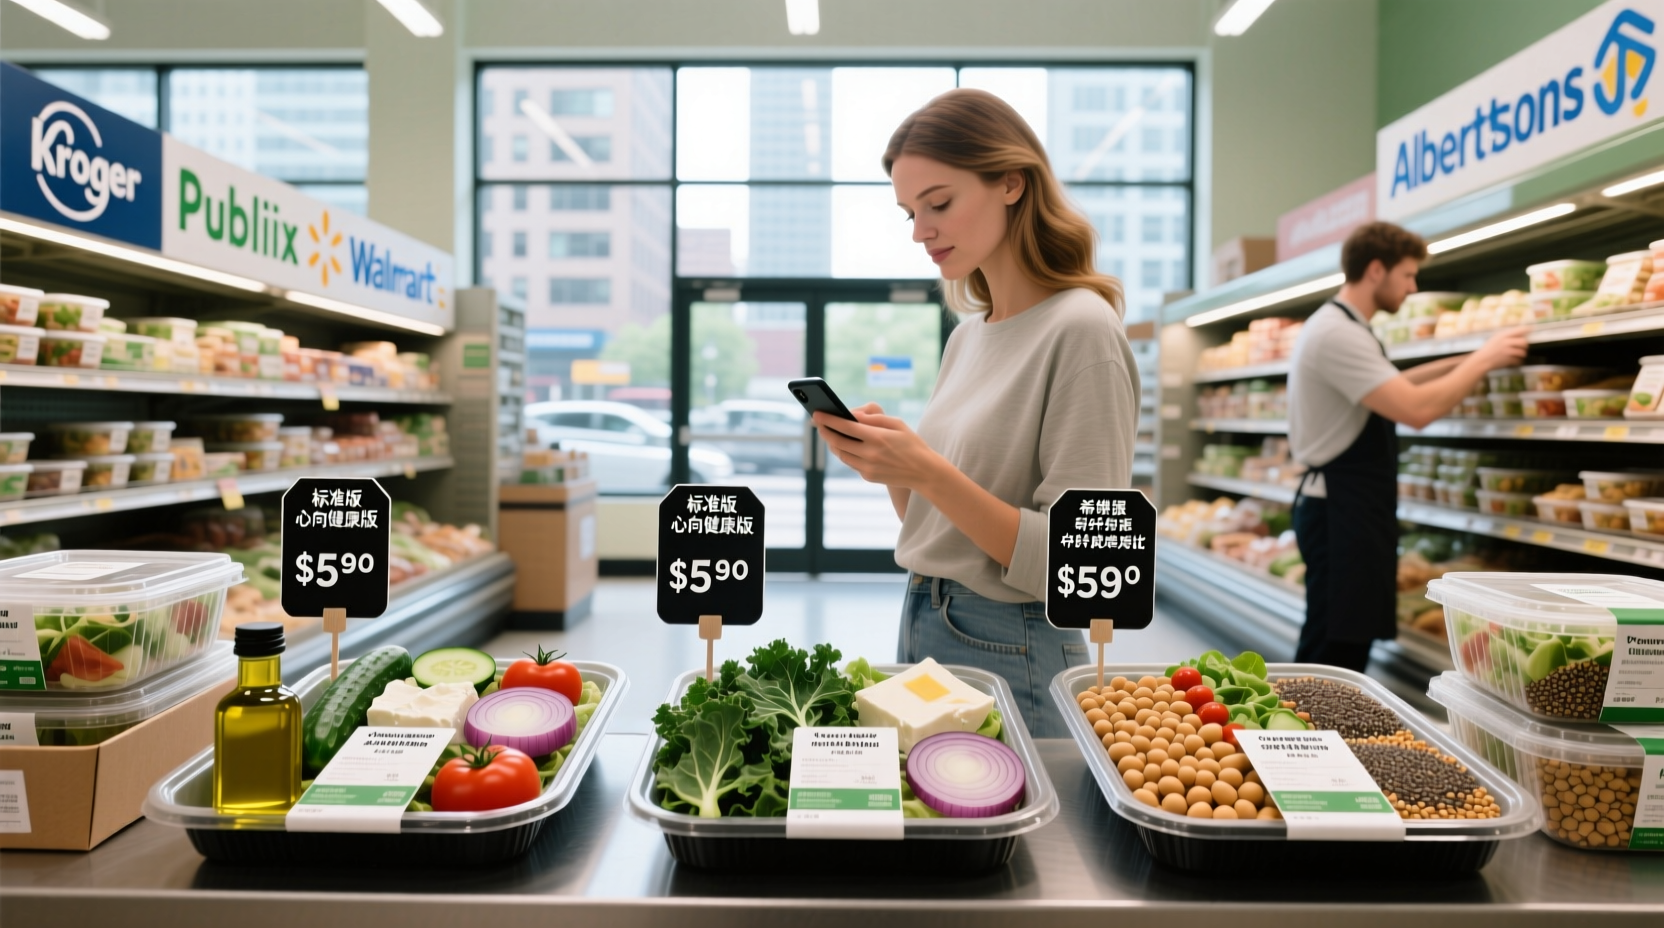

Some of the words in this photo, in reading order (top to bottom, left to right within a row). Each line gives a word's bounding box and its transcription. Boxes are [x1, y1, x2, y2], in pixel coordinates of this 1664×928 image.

[31, 115, 142, 212] Kroger
[179, 168, 298, 266] Publiix
[350, 235, 435, 304] Walmart
[312, 487, 362, 508] 标准版
[687, 493, 737, 514] 标准版
[671, 515, 754, 535] 心向健康版
